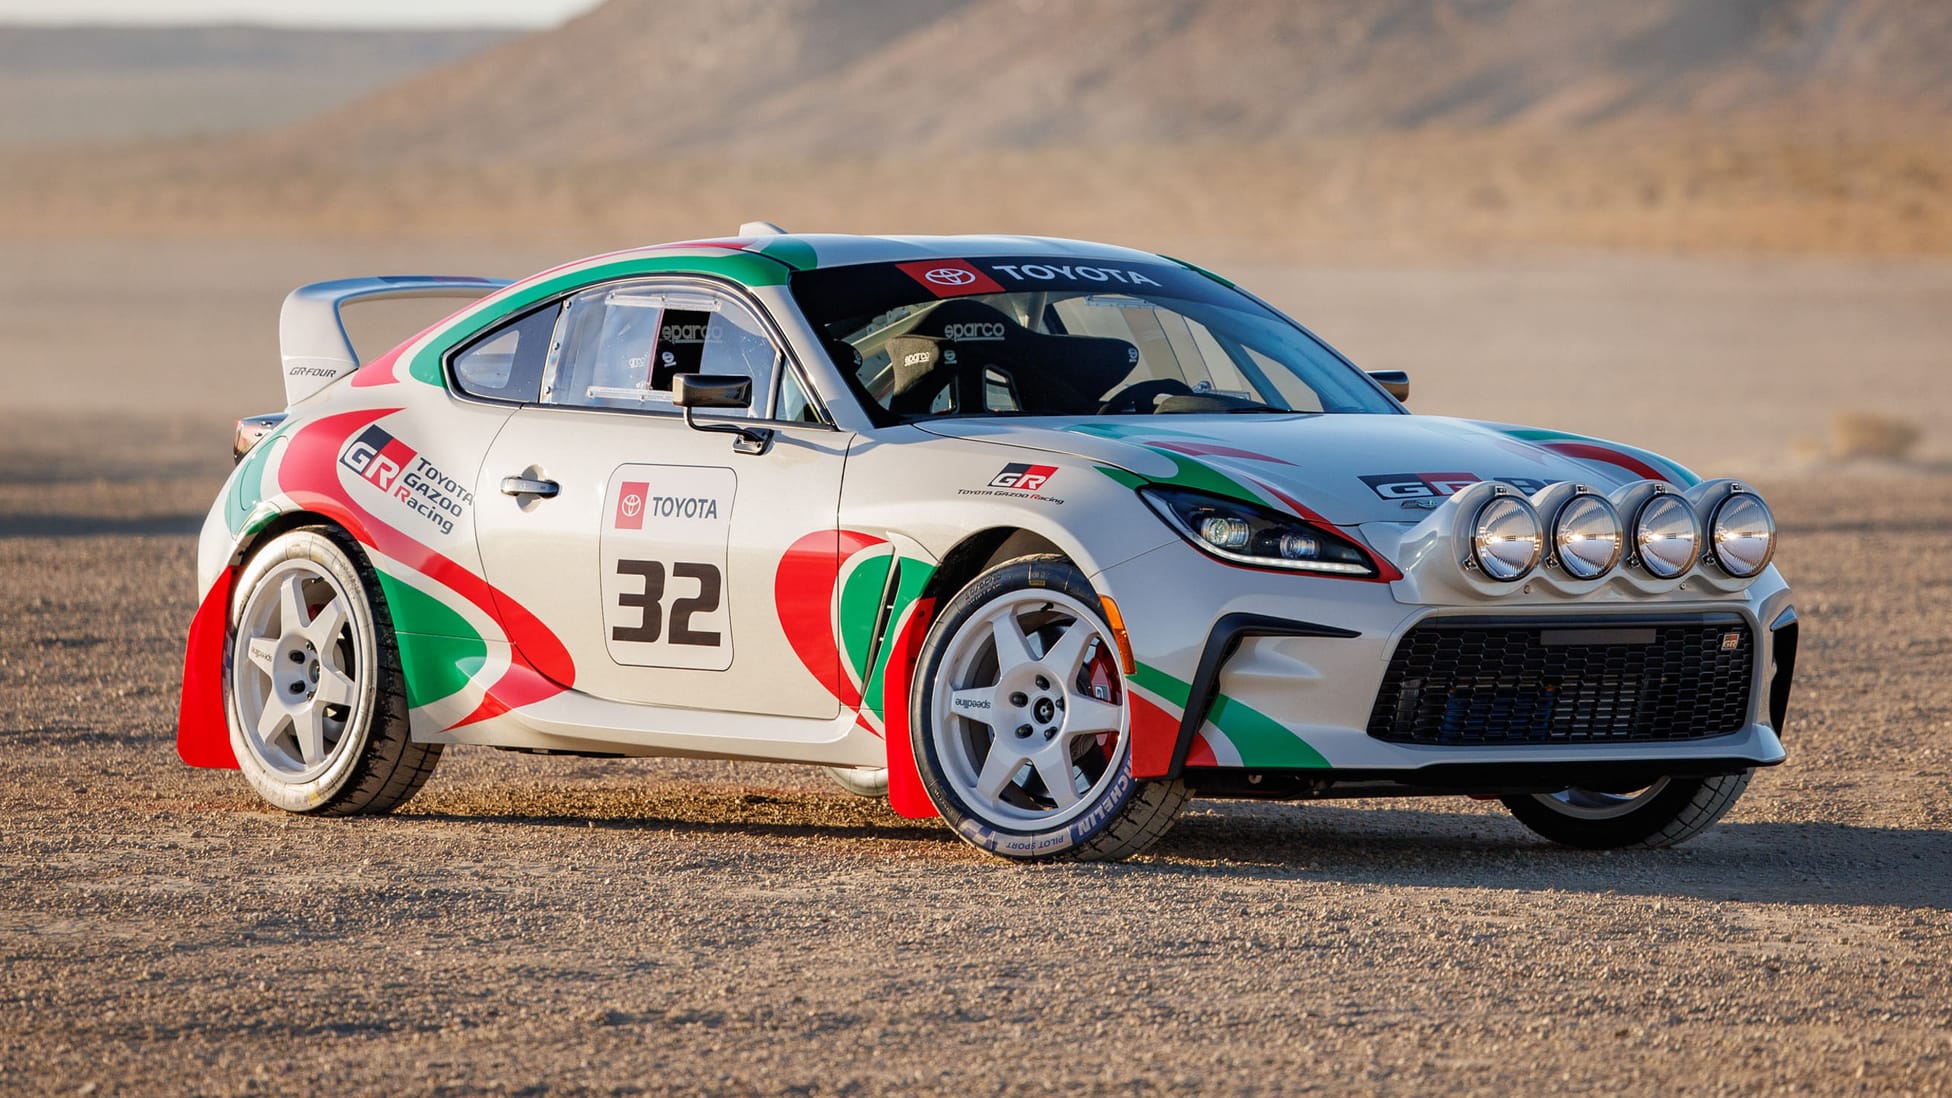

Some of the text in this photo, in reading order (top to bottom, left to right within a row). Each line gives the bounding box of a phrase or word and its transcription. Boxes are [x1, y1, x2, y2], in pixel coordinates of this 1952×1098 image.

[992, 264, 1162, 288] TOYOTA
[944, 322, 1005, 342] sparco
[343, 440, 401, 490] GR
[417, 456, 474, 506] TOYOTA
[990, 472, 1047, 490] GR
[393, 485, 454, 535] Racing
[403, 472, 463, 518] GAZOO
[652, 496, 718, 520] TOYOTA
[957, 488, 1065, 505] TOYOTA GAZOO Racing
[612, 558, 722, 648] 32
[1077, 758, 1132, 837] ICHELIN
[1005, 834, 1064, 851] PILOT SPORT
